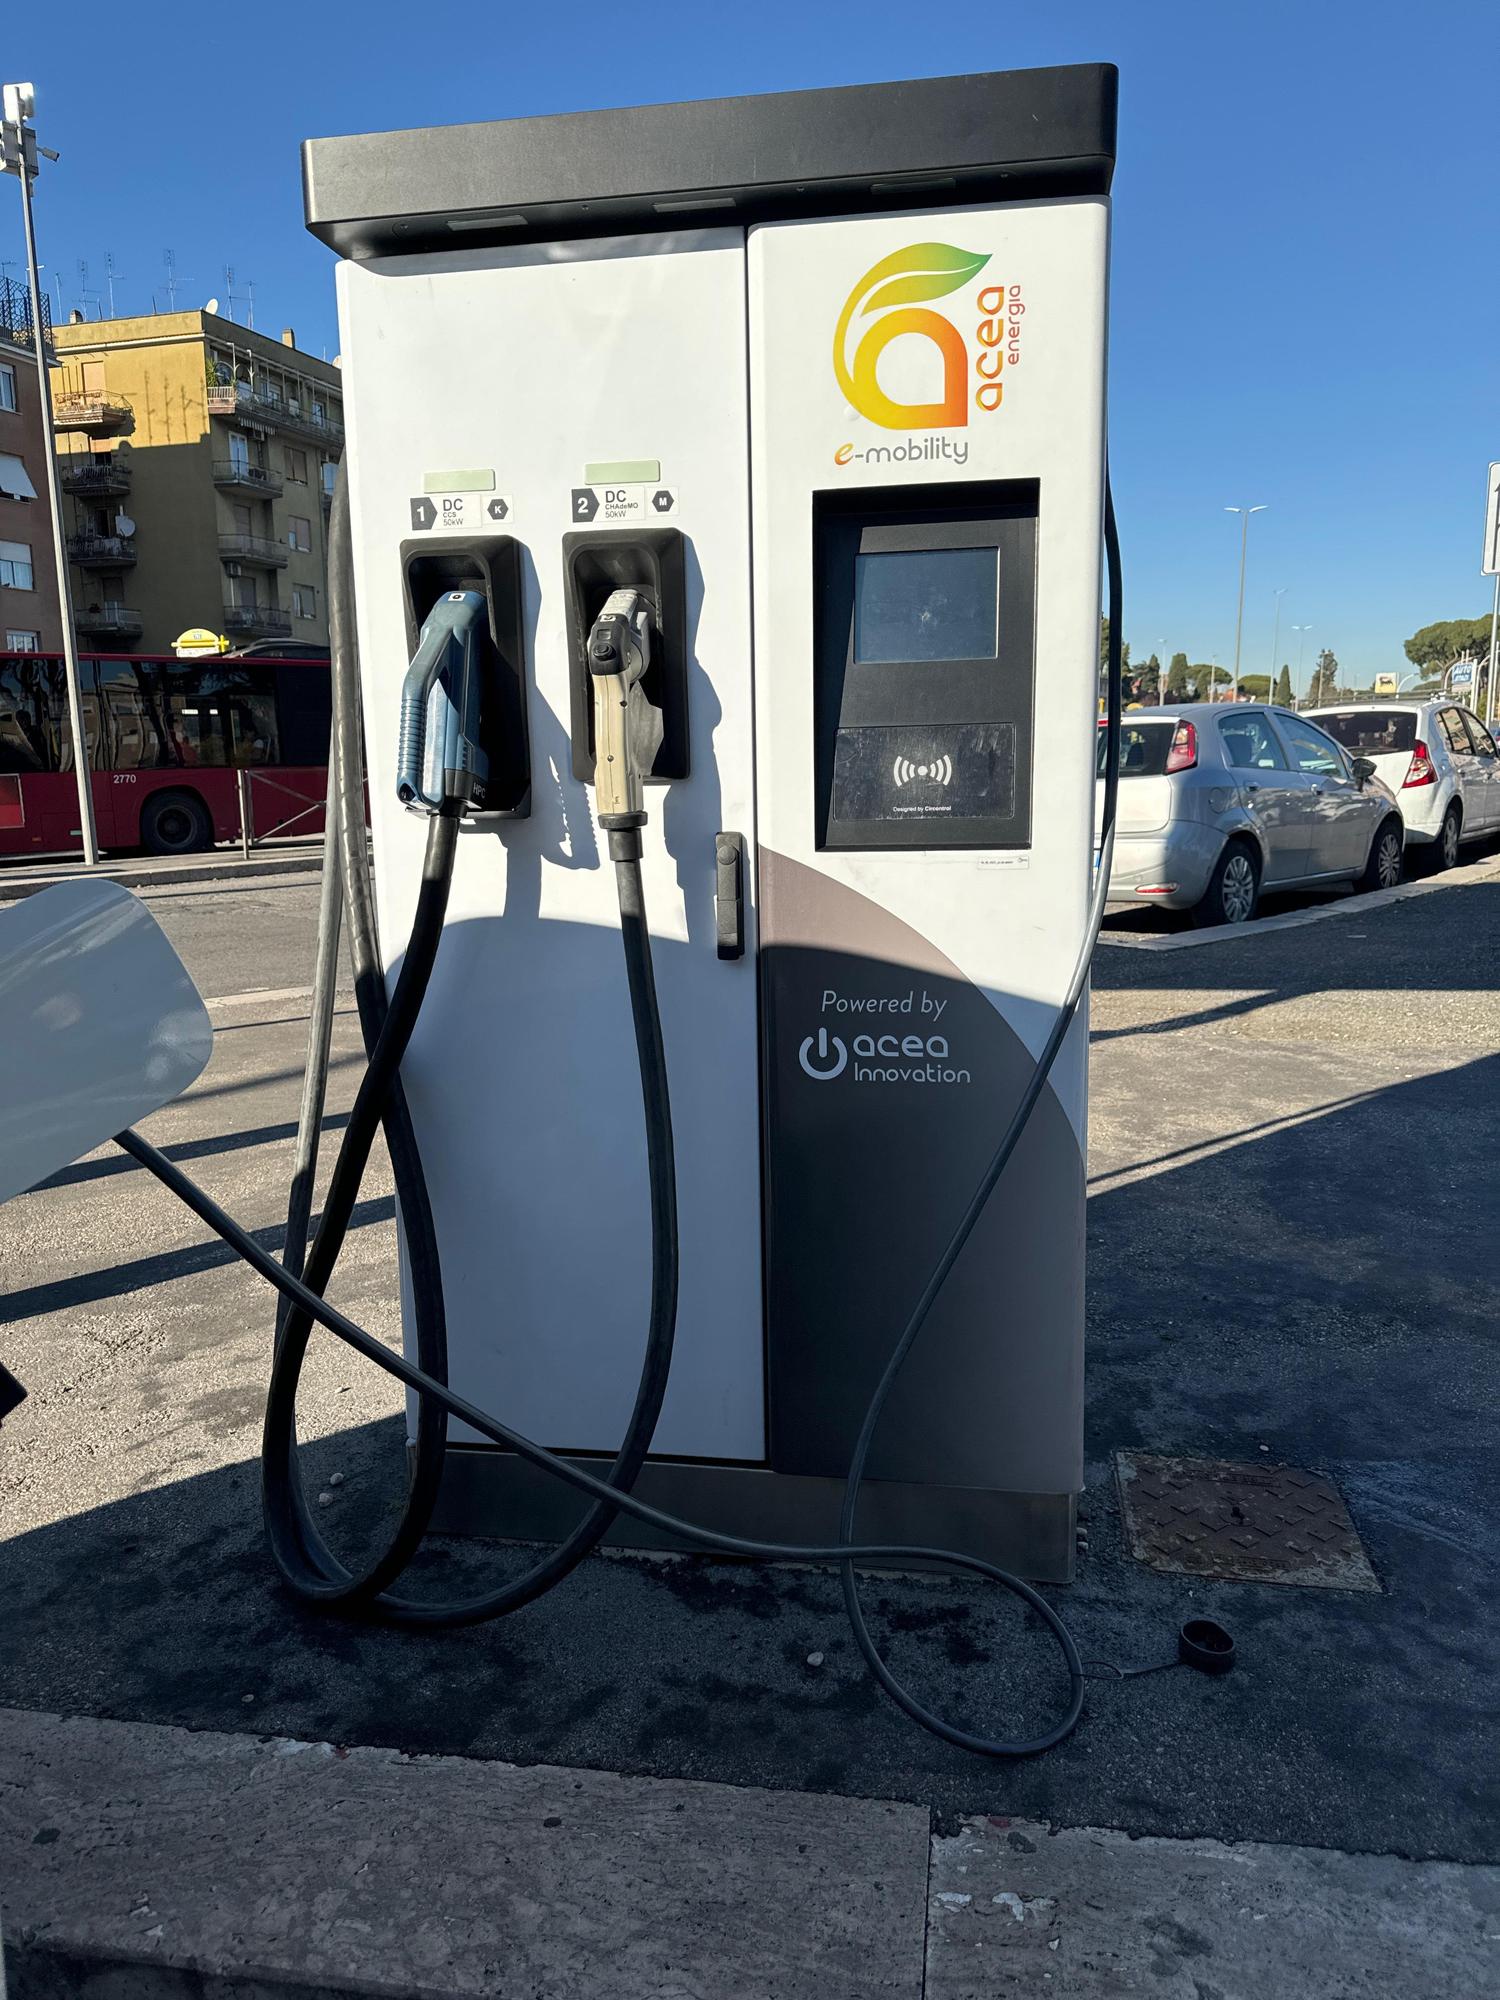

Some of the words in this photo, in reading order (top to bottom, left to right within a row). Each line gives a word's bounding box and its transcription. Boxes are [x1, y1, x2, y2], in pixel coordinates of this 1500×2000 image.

[1008, 285, 1026, 365] energia
[975, 286, 1005, 412] acea
[834, 436, 969, 466] e-mobility
[442, 498, 463, 511] DC
[605, 490, 627, 503] DC
[658, 497, 668, 506] M
[494, 505, 502, 514] K
[577, 497, 589, 514] 2
[605, 502, 639, 510] CHAdeMO
[416, 506, 425, 522] 1
[443, 518, 464, 526] 50kW
[605, 510, 627, 518] 50kW
[113, 774, 137, 784] 2770
[472, 782, 486, 799] HPC
[821, 990, 914, 1013] Powered
[921, 991, 948, 1022] by
[853, 1034, 949, 1058] acea
[854, 1062, 971, 1083] Innovation
